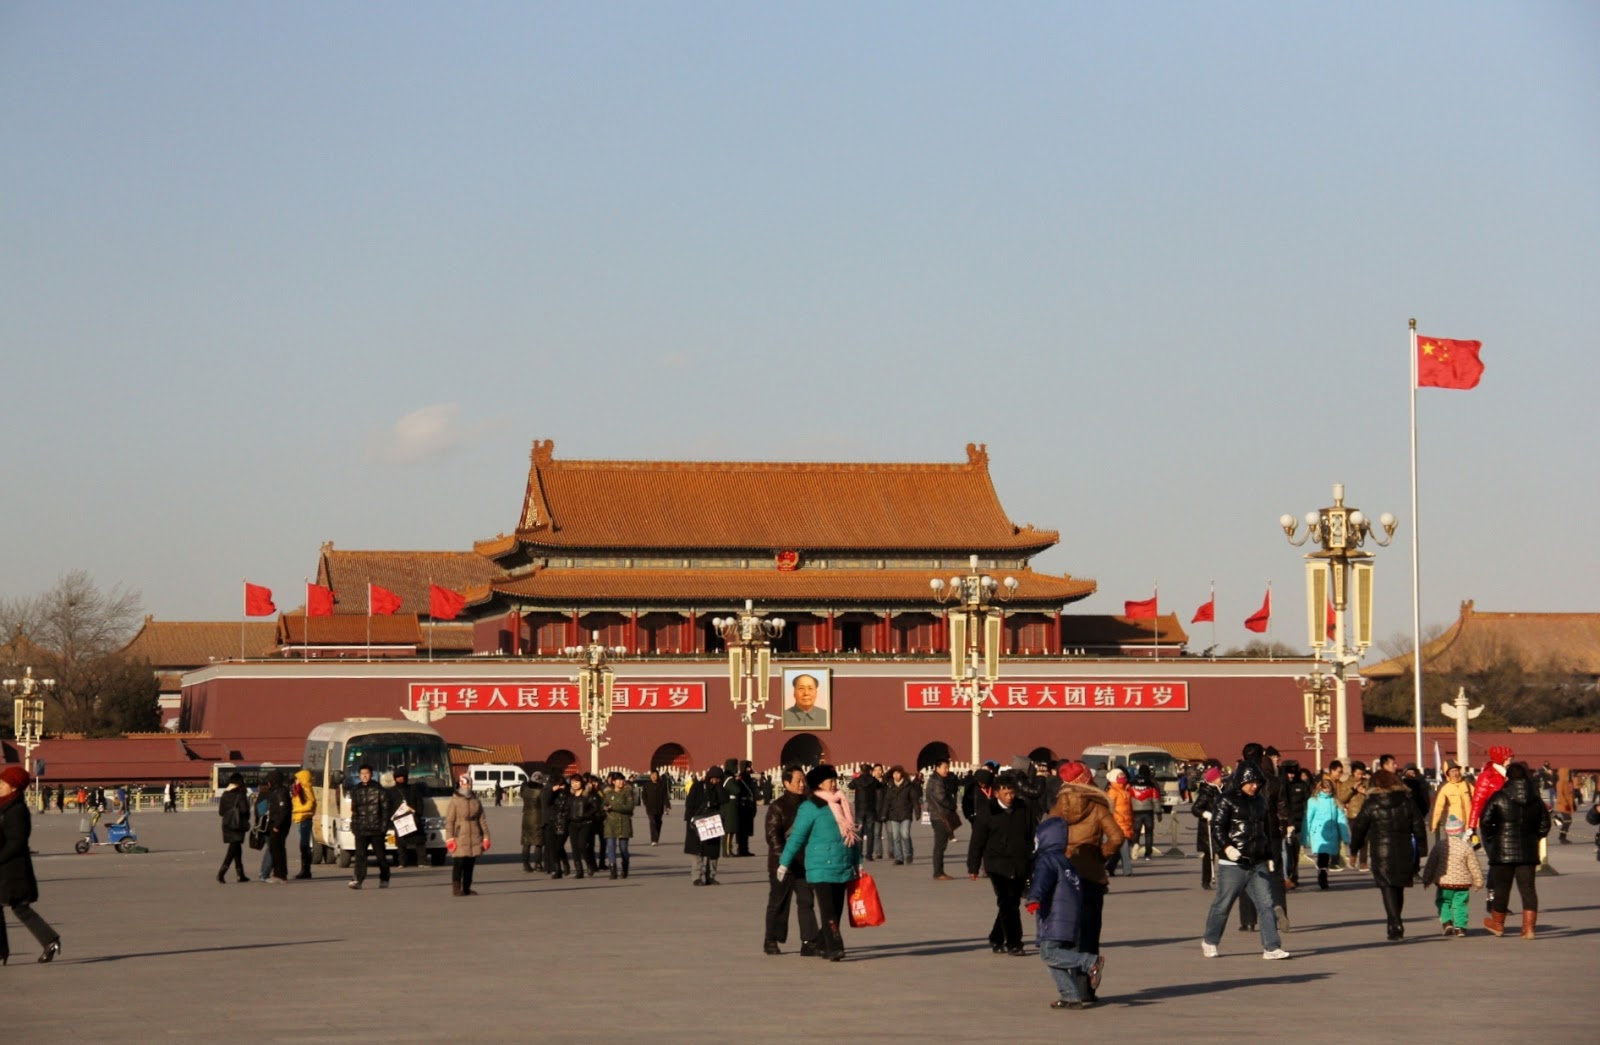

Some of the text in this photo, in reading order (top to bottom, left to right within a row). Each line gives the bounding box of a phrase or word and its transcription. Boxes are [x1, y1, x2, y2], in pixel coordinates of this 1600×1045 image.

[425, 687, 690, 708] 中华人民共国万岁
